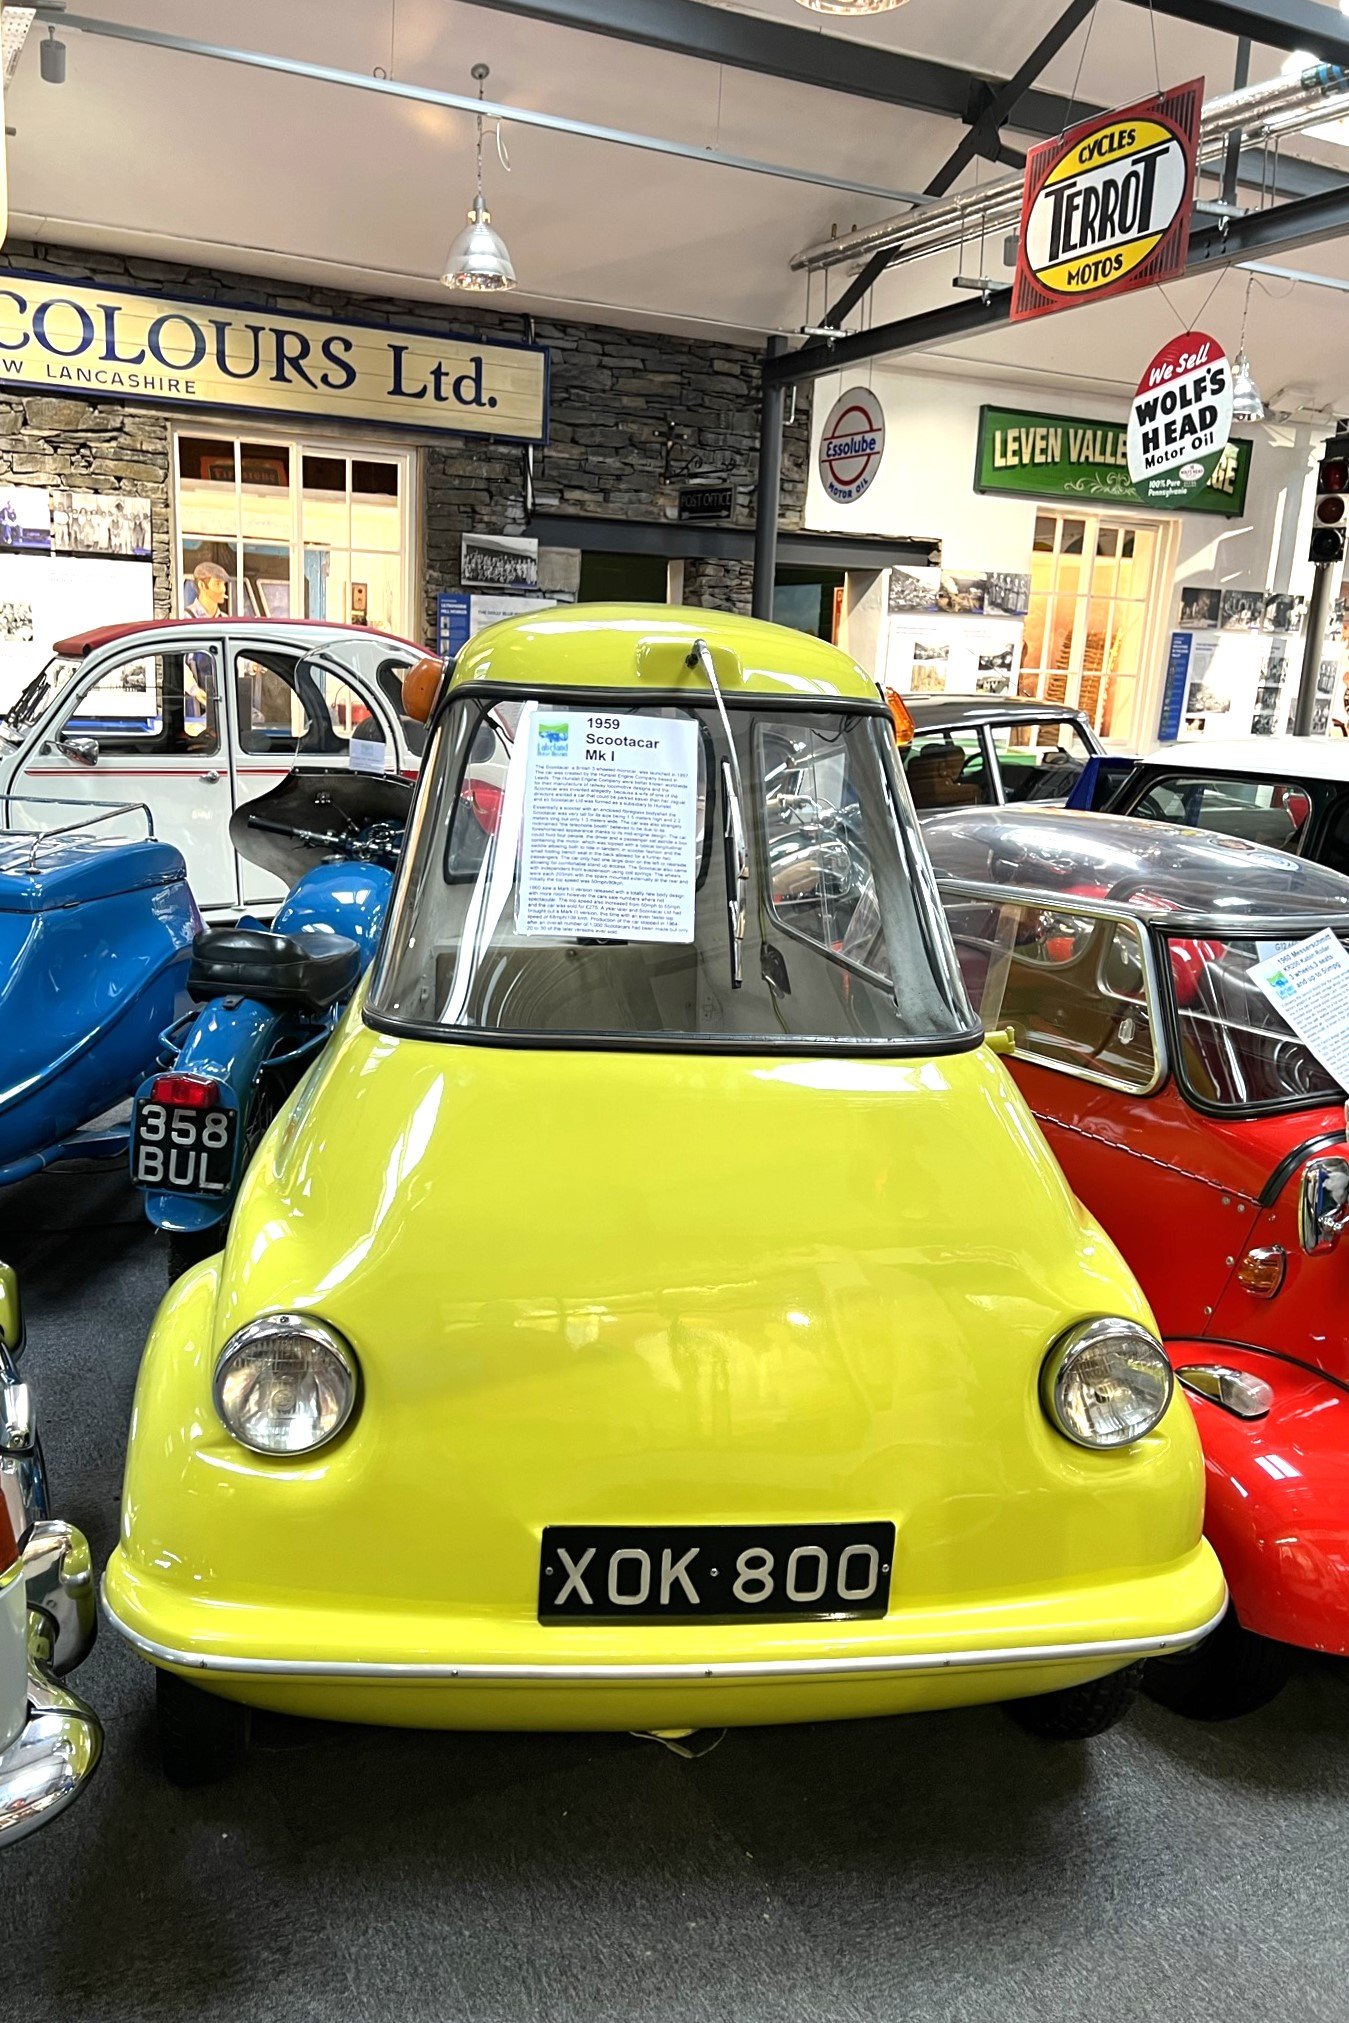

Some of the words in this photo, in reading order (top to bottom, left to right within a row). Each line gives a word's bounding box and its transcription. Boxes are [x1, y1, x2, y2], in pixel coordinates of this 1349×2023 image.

[1079, 128, 1136, 164] CYCLES
[1045, 146, 1170, 262] TERROT
[1067, 253, 1123, 286] MOTOS
[46, 363, 197, 394] LANCASHIRE
[387, 343, 498, 408] Ltd.
[1148, 362, 1172, 387] We
[1176, 341, 1210, 373] Sell
[1135, 367, 1226, 427] WOLF'S
[826, 435, 876, 458] Essolube
[994, 427, 1063, 468] LEVEN
[1069, 429, 1127, 466] VALLE
[1142, 405, 1218, 455] HEAD
[1144, 446, 1185, 470] Motor
[1192, 431, 1214, 450] Oil
[681, 494, 702, 508] POST
[828, 481, 852, 499] MOTOR
[856, 478, 868, 493] OIL
[1166, 478, 1180, 488] Pure
[586, 718, 620, 730] 1959
[586, 734, 660, 749] Scootacar
[586, 750, 606, 761] Mk
[611, 751, 614, 762] I
[140, 1104, 228, 1148] 358
[138, 1145, 225, 1190] BUL
[554, 1547, 700, 1605] XOK
[733, 1544, 879, 1603] 800
